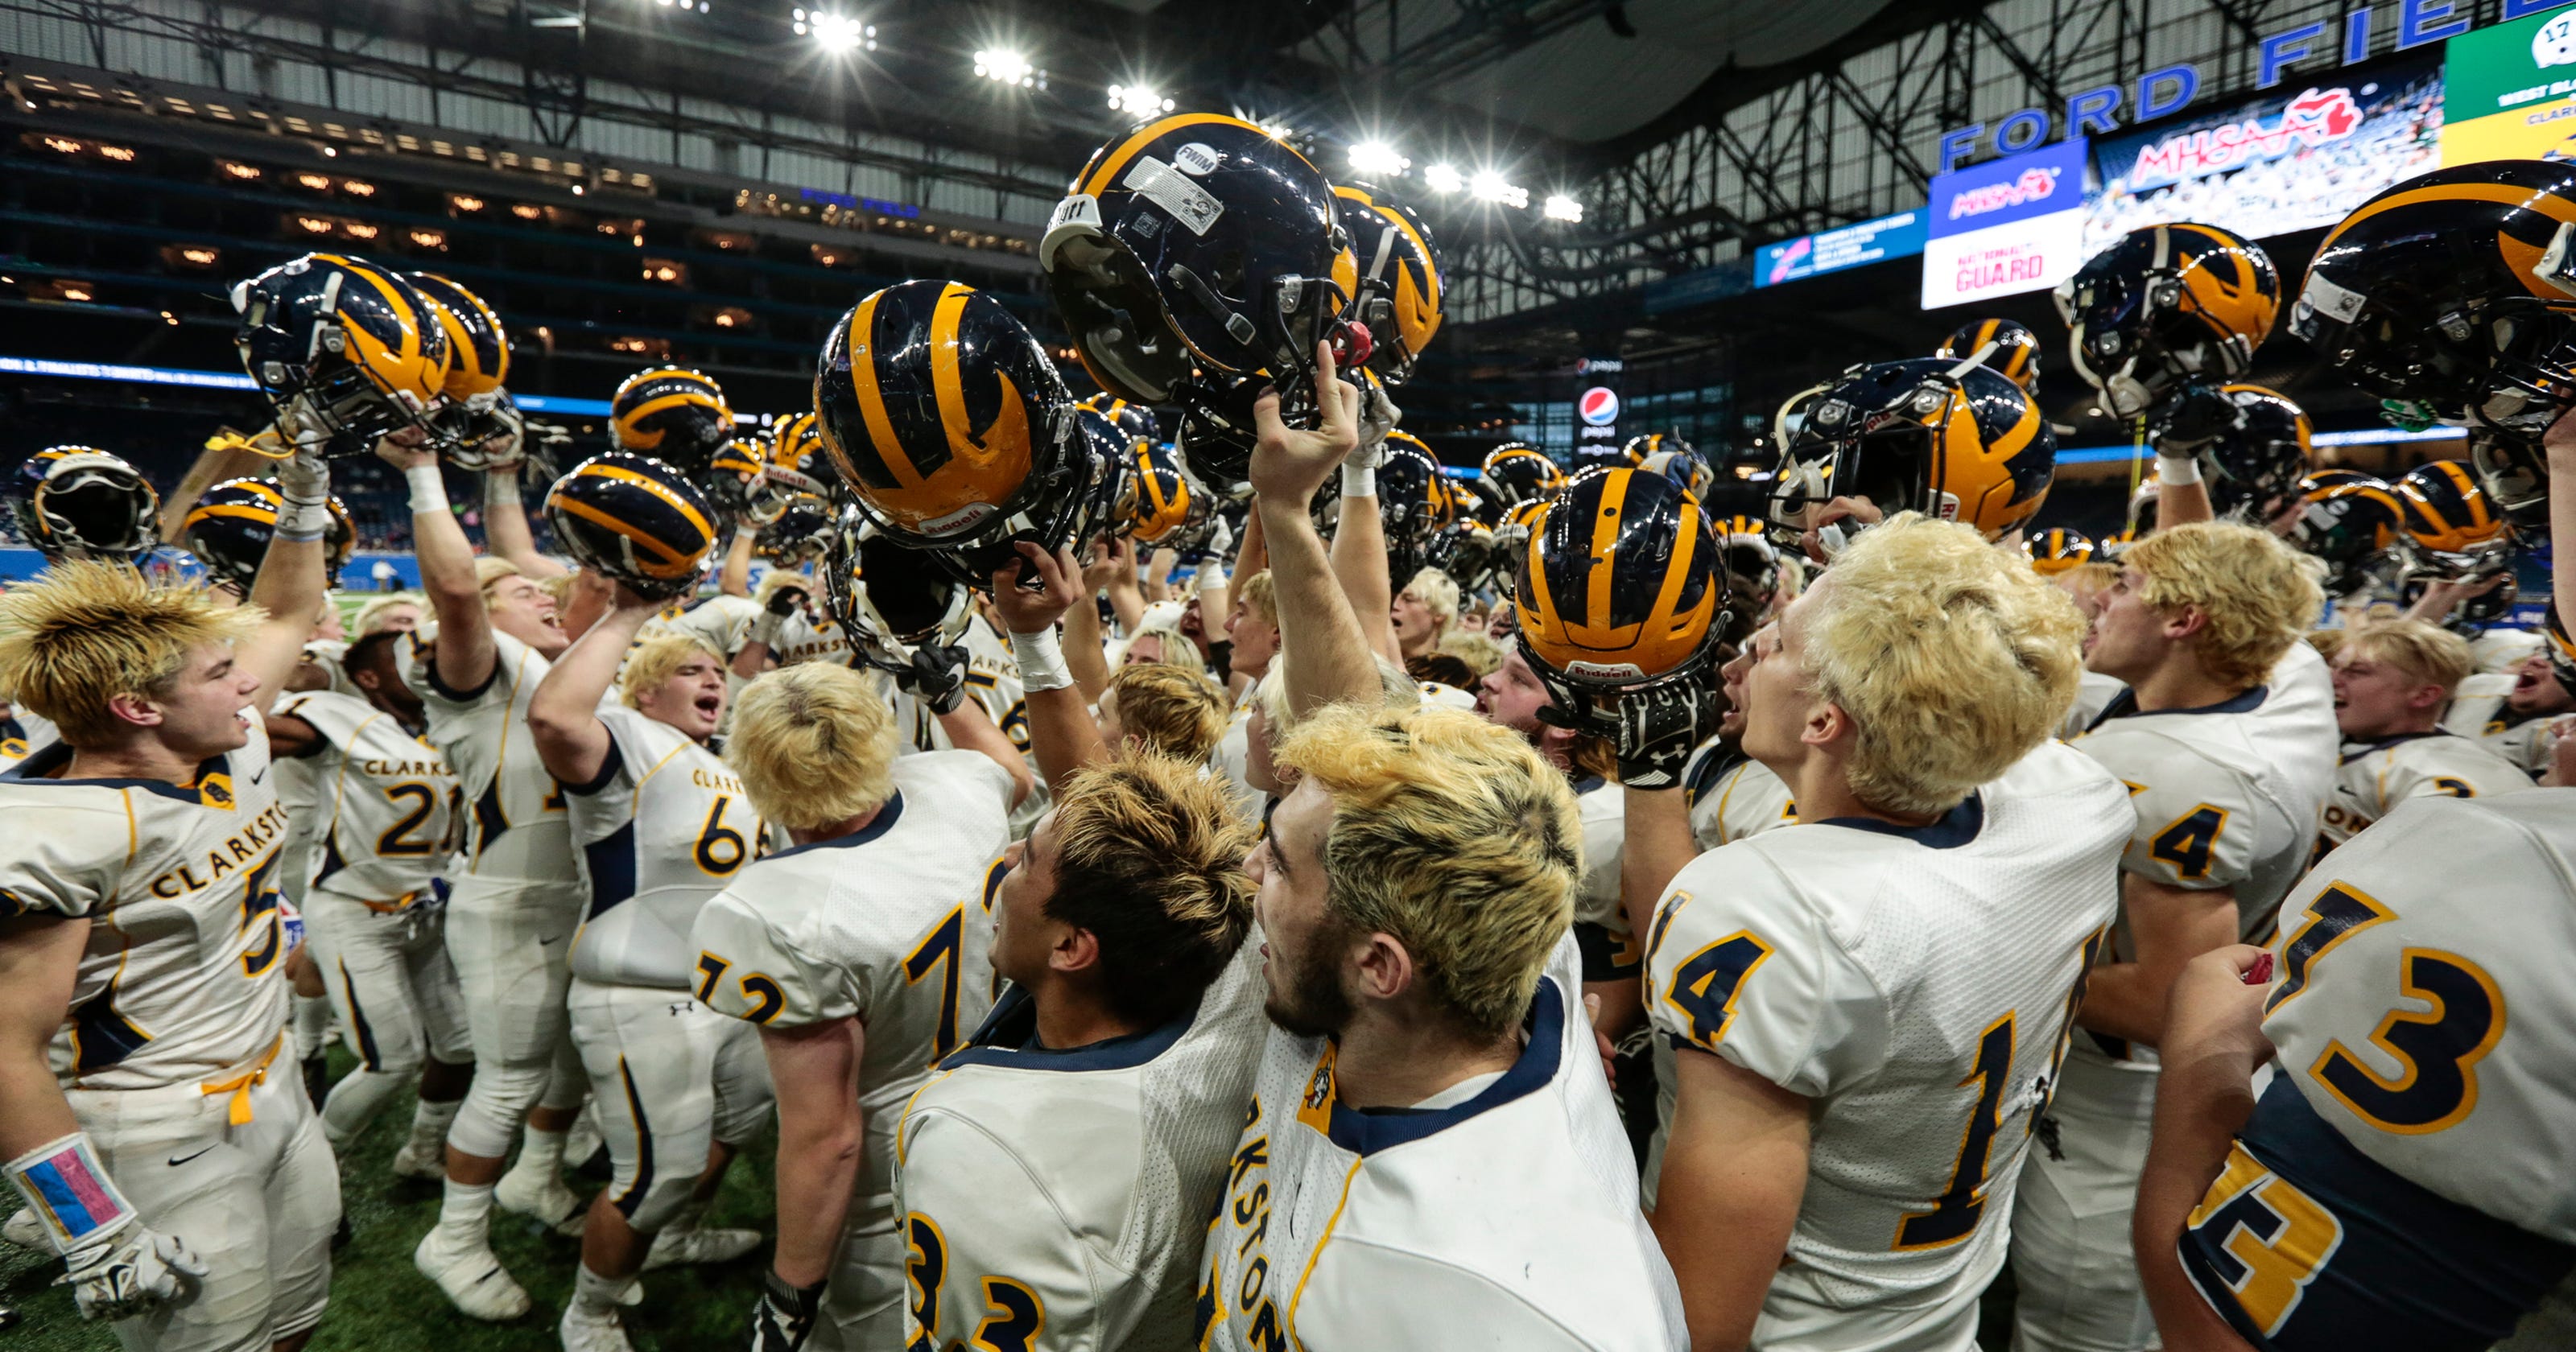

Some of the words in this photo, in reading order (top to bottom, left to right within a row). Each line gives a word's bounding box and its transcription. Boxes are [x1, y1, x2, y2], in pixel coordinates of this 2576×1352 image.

[2545, 20, 2570, 43] 17
[2549, 77, 2576, 96] BL
[1940, 64, 2201, 176] FORD
[2526, 106, 2576, 125] CLAR
[2132, 109, 2318, 179] MHSAA
[1179, 146, 1215, 171] FWIM
[1956, 255, 2042, 292] GUARD
[1590, 361, 1623, 373] pepsi
[1581, 426, 1615, 439] pepsi
[1575, 666, 1633, 678] Riddell
[375, 781, 464, 857] 21
[1641, 888, 1776, 1048] 14
[2260, 879, 2507, 1136] 13
